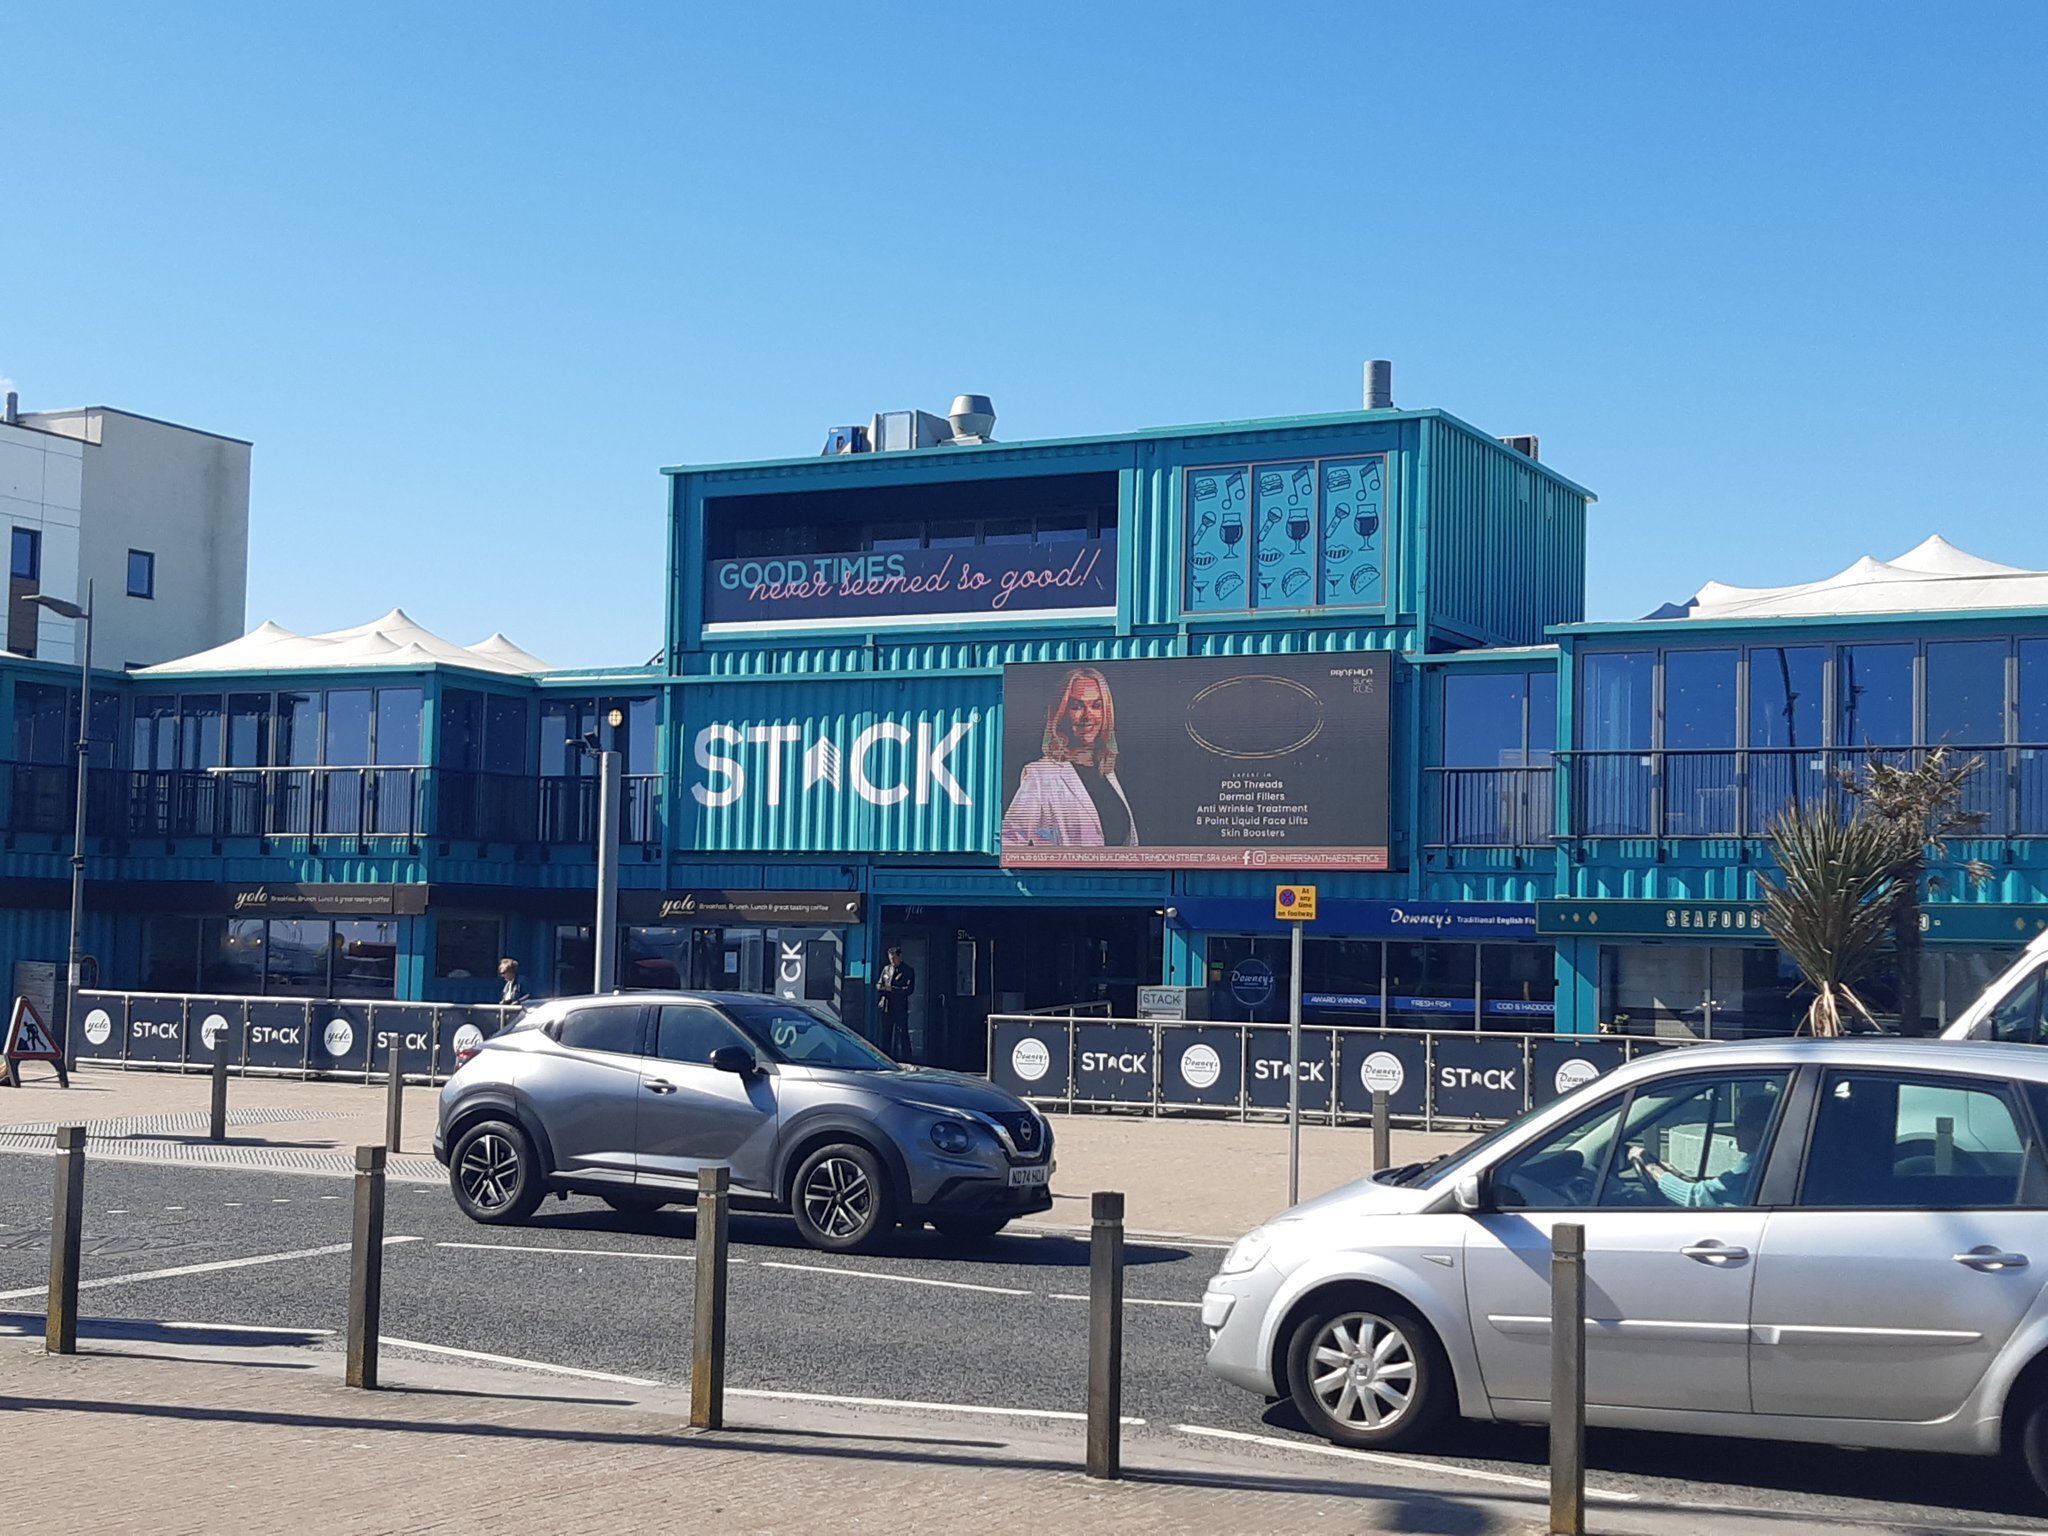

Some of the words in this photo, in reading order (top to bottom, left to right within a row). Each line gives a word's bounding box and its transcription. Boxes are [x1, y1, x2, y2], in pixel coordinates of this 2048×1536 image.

[719, 561, 807, 590] GOOD
[814, 554, 905, 584] TIMES
[750, 571, 833, 600] never
[839, 554, 953, 597] seemed
[957, 563, 992, 590] so
[992, 548, 1101, 609] good!
[691, 720, 974, 807] STACK
[1221, 781, 1241, 789] PDO
[1244, 781, 1283, 789] Threads
[1219, 792, 1254, 801] Dermal
[1257, 792, 1285, 801] Fillers
[1197, 804, 1216, 813] Anti
[1218, 804, 1254, 813] Wrinkle
[1257, 804, 1308, 813] Treatment
[1205, 816, 1229, 825] Point
[1231, 816, 1260, 827] Liquid
[1262, 816, 1286, 825] Face
[1288, 815, 1308, 825] Lifts
[1221, 828, 1240, 837] Skin
[1243, 828, 1285, 837] Boosters
[1140, 853, 1175, 861] TRIMDON
[234, 885, 268, 910] yolo
[659, 893, 696, 917] yolo
[790, 904, 810, 912] tasting
[1287, 910, 1313, 918] footway
[1389, 907, 1452, 929] Downey's
[1457, 916, 1495, 924] Traditional
[1497, 917, 1523, 926] English
[1525, 917, 1536, 925] Fis
[1231, 969, 1274, 986] Downey's
[1143, 993, 1181, 1005] STACK
[1311, 996, 1337, 1004] AWARD
[1338, 997, 1367, 1005] WINNING
[1411, 1000, 1434, 1008] FRESH
[1435, 1000, 1451, 1008] FISH
[86, 1017, 109, 1033] yolo
[133, 1022, 179, 1039] STACK
[252, 1027, 299, 1044] STACK
[325, 1029, 351, 1045] yolo
[377, 1032, 427, 1050] STCK
[1015, 1050, 1047, 1062] Downey's
[1082, 1052, 1146, 1073] STACK
[1184, 1056, 1218, 1069] Downey's
[1364, 1064, 1401, 1078] Downey's
[1441, 1068, 1516, 1090] STACK
